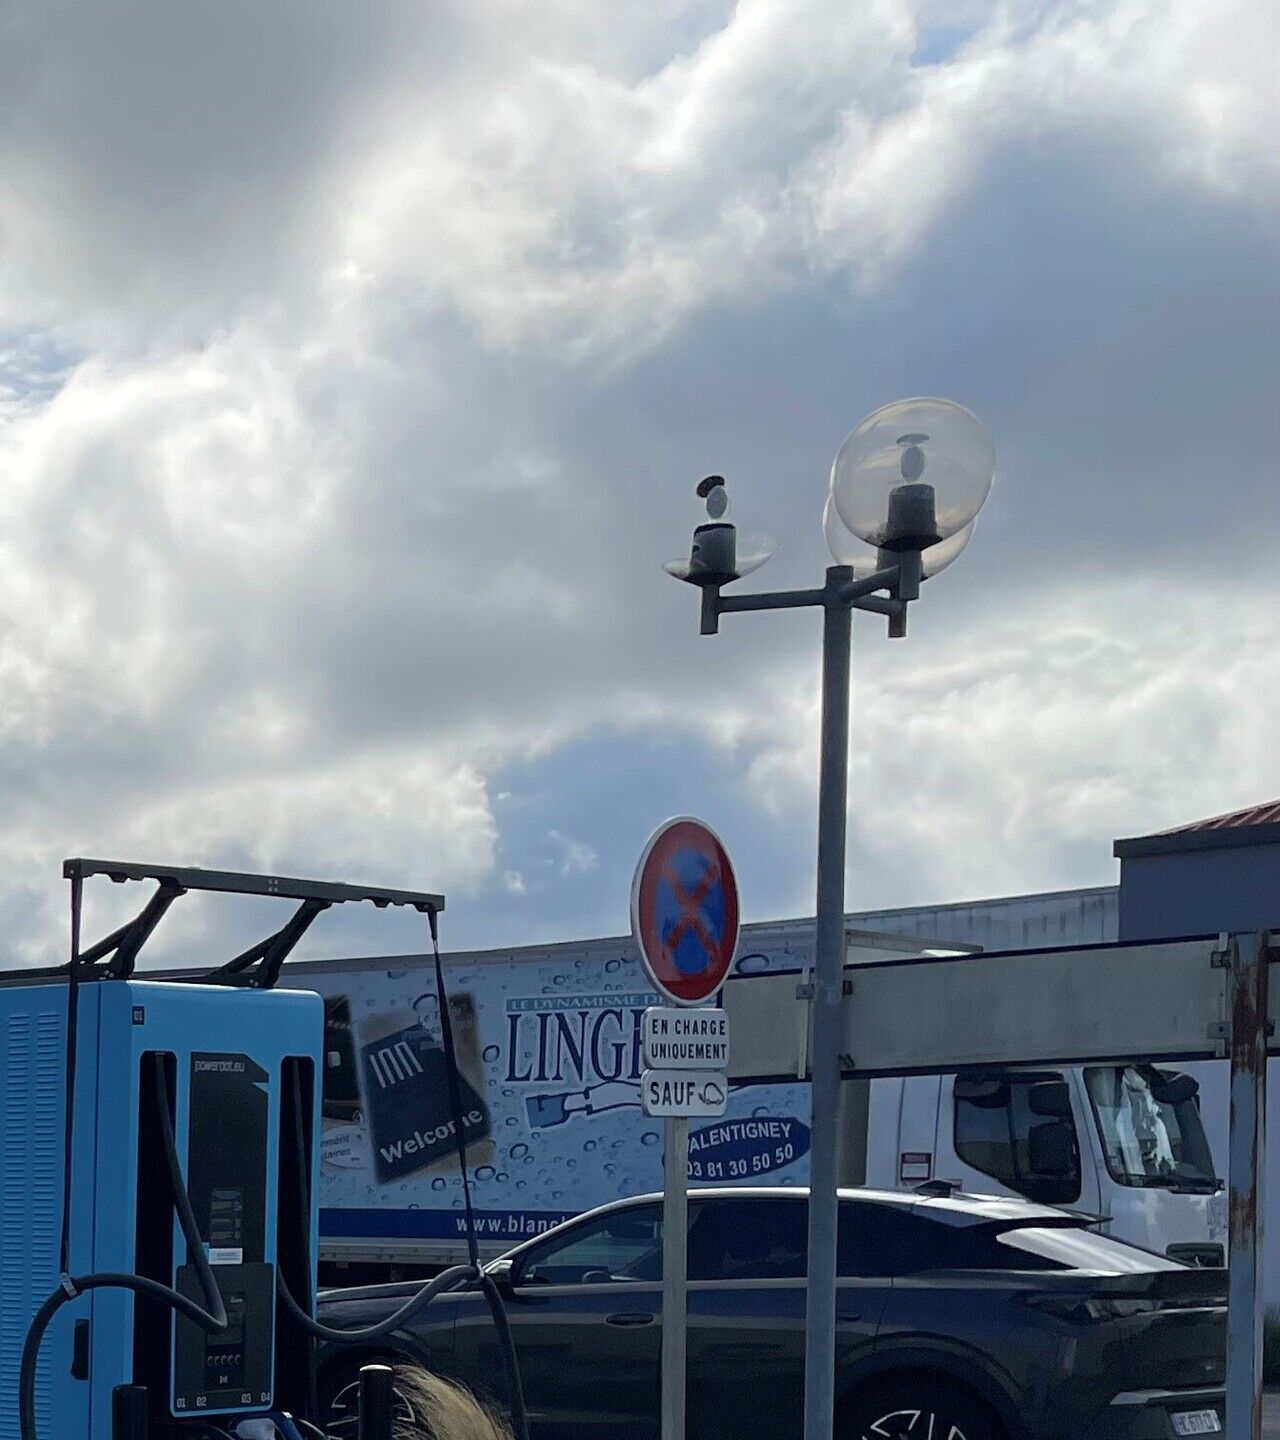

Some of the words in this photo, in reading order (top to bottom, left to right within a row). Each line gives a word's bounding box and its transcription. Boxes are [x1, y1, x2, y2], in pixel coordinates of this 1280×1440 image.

[534, 994, 635, 1008] DYNAMISME
[652, 1019, 668, 1034] EN
[675, 1020, 726, 1036] CHARGE
[651, 1044, 727, 1060] UNIQUEMENT
[650, 1081, 695, 1105] SAUF
[689, 1122, 792, 1152] ALENTIGNEY
[707, 1162, 723, 1177] 81
[729, 1159, 748, 1175] 30
[752, 1153, 771, 1171] 50
[775, 1143, 793, 1163] 50
[456, 1215, 566, 1233] www.blanc
[176, 1398, 186, 1408] 01
[196, 1396, 207, 1407] 02
